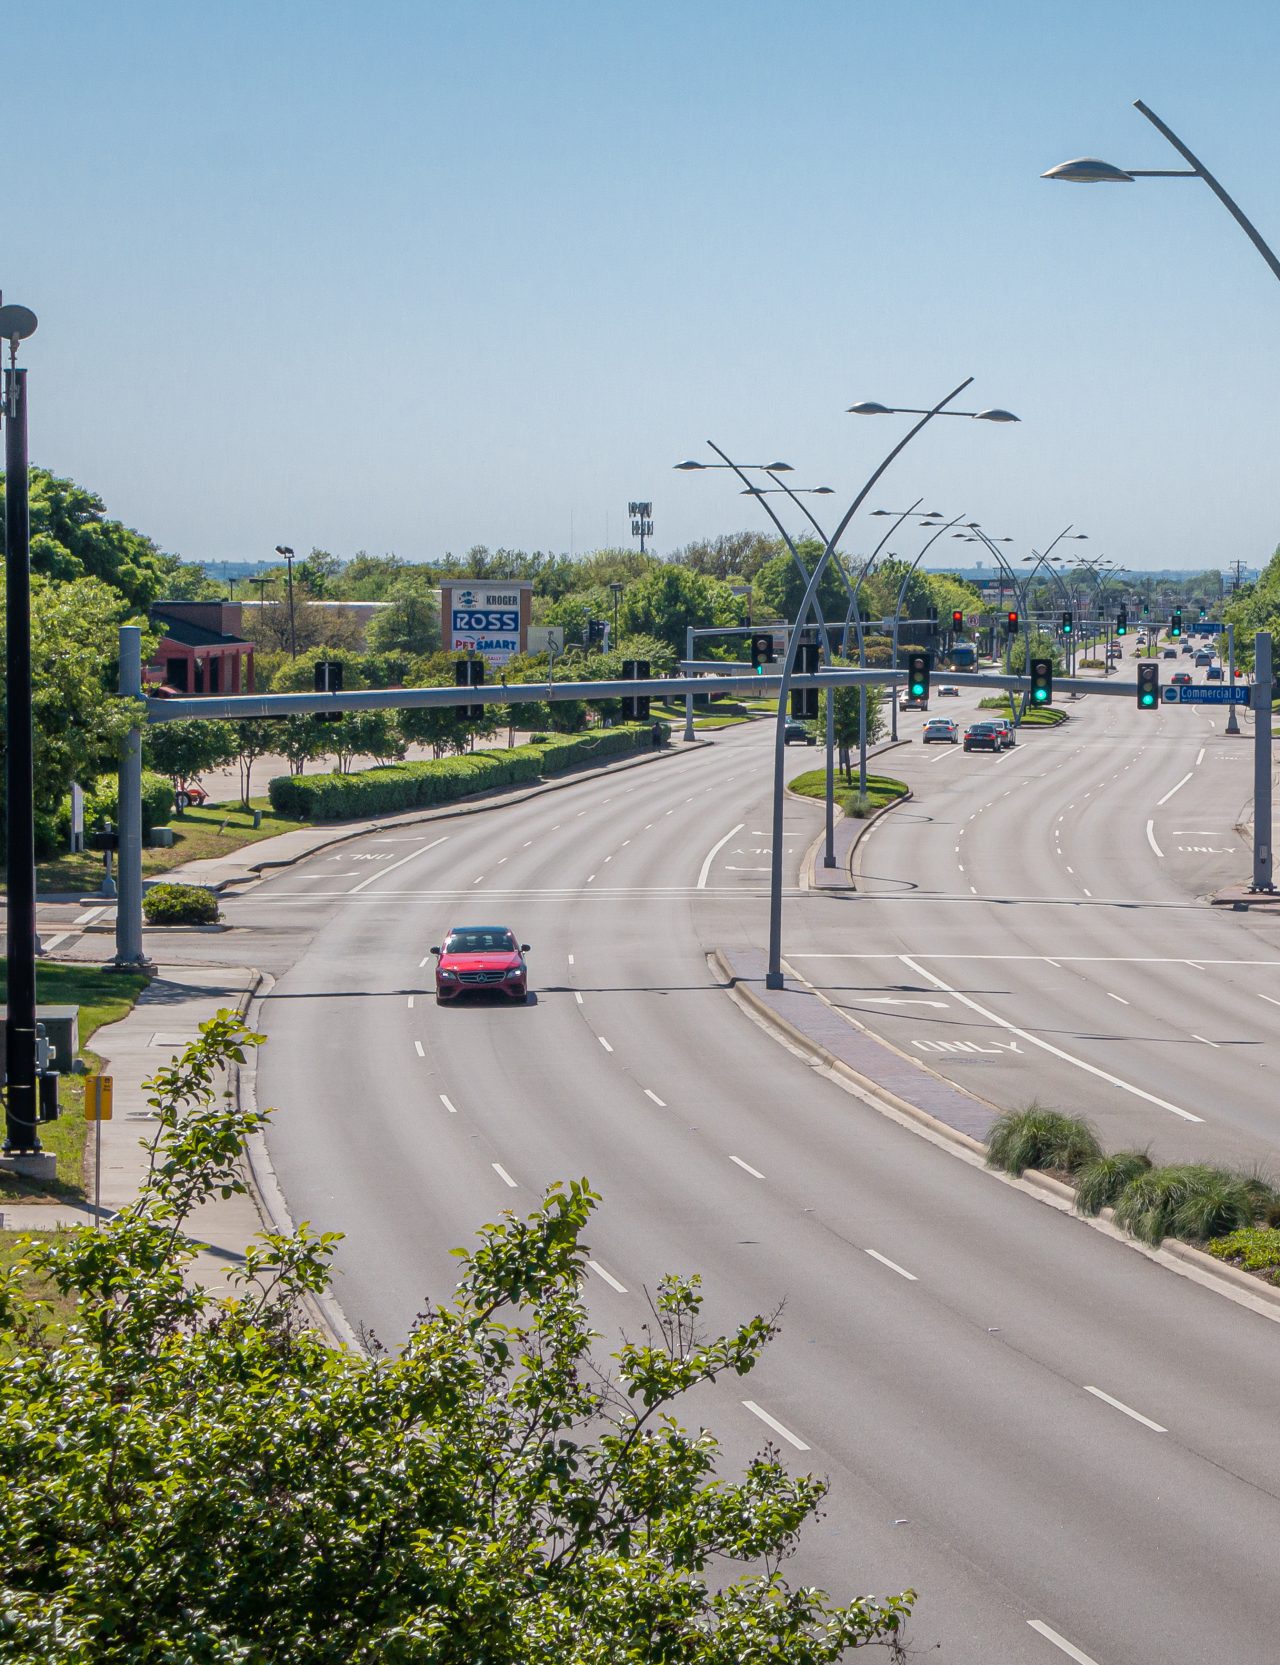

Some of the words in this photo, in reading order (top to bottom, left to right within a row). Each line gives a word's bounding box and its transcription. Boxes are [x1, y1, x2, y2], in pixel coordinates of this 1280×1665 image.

[487, 595, 518, 606] KROGER
[456, 613, 515, 630] ROSS
[1181, 686, 1233, 698] Commercial
[1235, 687, 1245, 698] Dr
[911, 1040, 1025, 1054] ONLY
